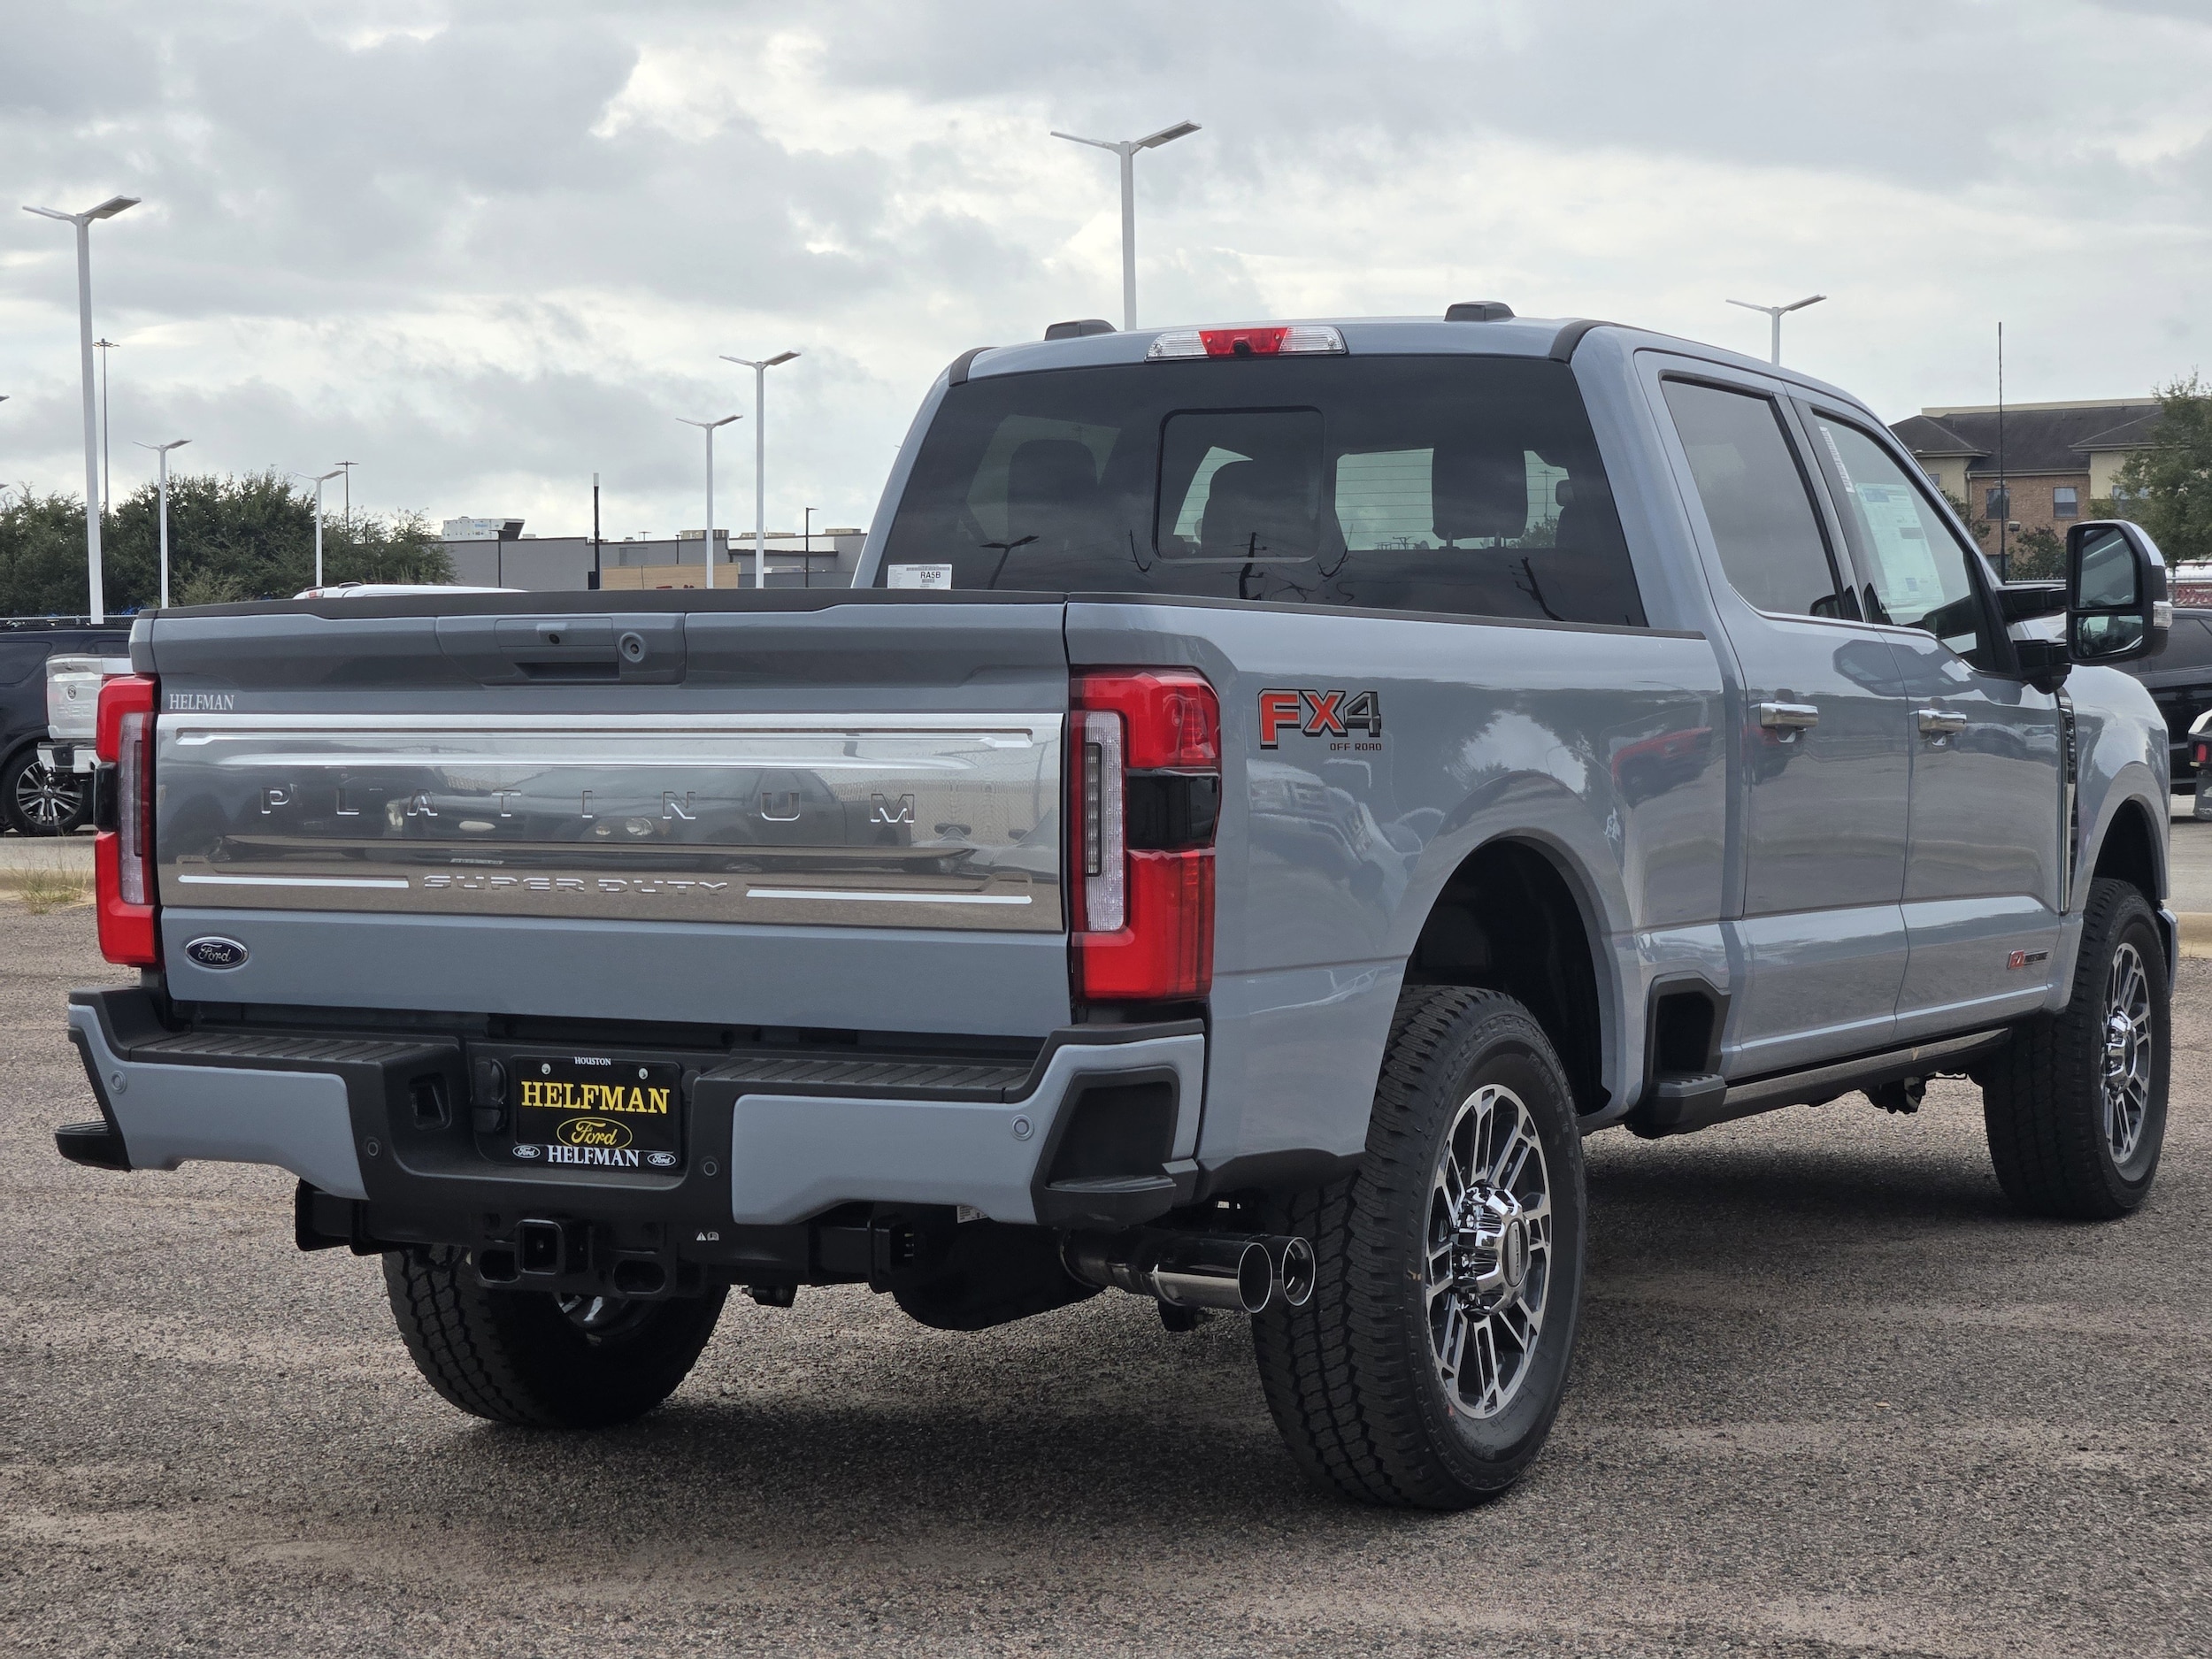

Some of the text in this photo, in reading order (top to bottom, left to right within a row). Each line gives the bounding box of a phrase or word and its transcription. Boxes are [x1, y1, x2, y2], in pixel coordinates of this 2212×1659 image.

[169, 694, 234, 710] HELFMAN
[1257, 688, 1381, 749] FX4
[261, 787, 916, 824] PLATINUM
[424, 874, 728, 895] SUPER DUTY
[197, 943, 232, 962] Ford
[574, 1056, 611, 1066] HOUSTON
[521, 1081, 670, 1114] HELFMAN
[571, 1120, 618, 1146] Ford
[547, 1145, 640, 1167] HELFMAN
